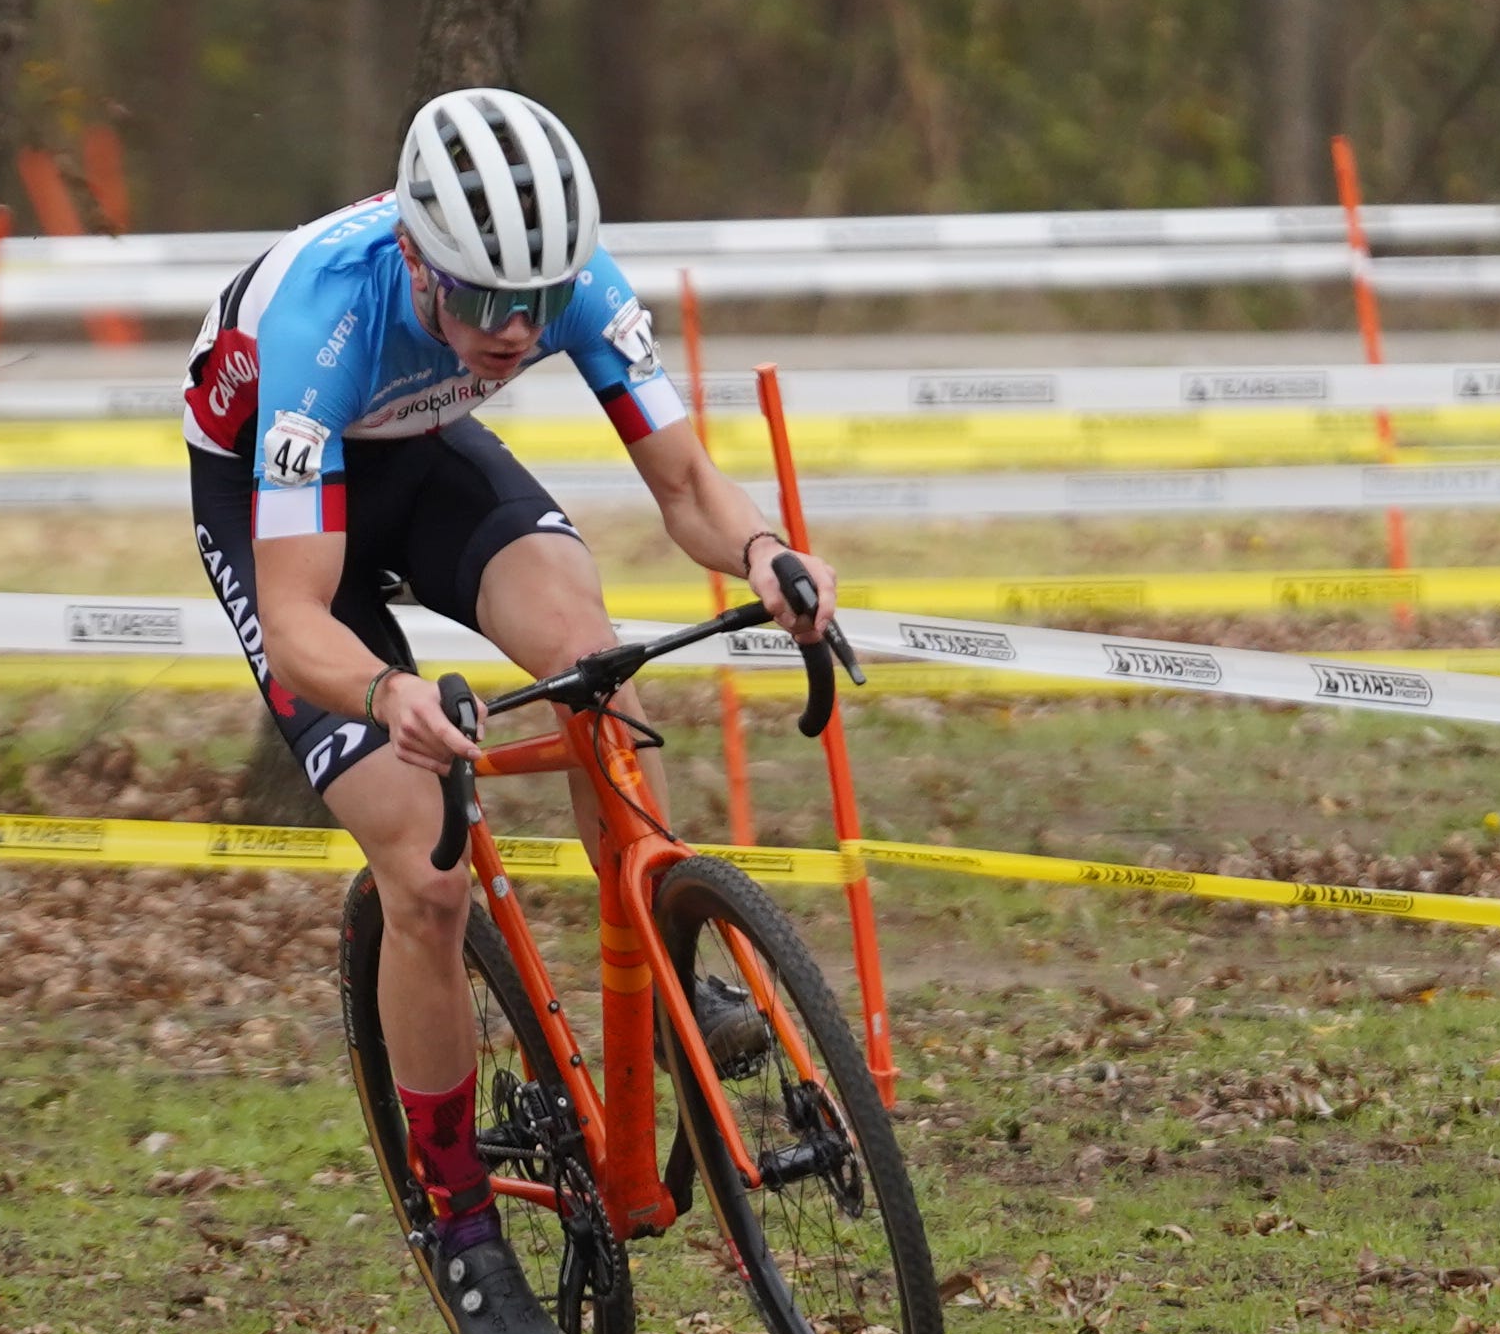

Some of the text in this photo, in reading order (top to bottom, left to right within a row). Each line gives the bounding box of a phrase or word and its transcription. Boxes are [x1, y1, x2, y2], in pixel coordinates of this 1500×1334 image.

[274, 437, 312, 476] 44
[196, 524, 268, 683] CANADA
[747, 633, 798, 650] TEXA
[923, 633, 978, 657] TEXAS
[1128, 652, 1183, 676] TEXAS
[1337, 672, 1393, 696] TEXAS
[1395, 688, 1427, 700] SYNDICATE
